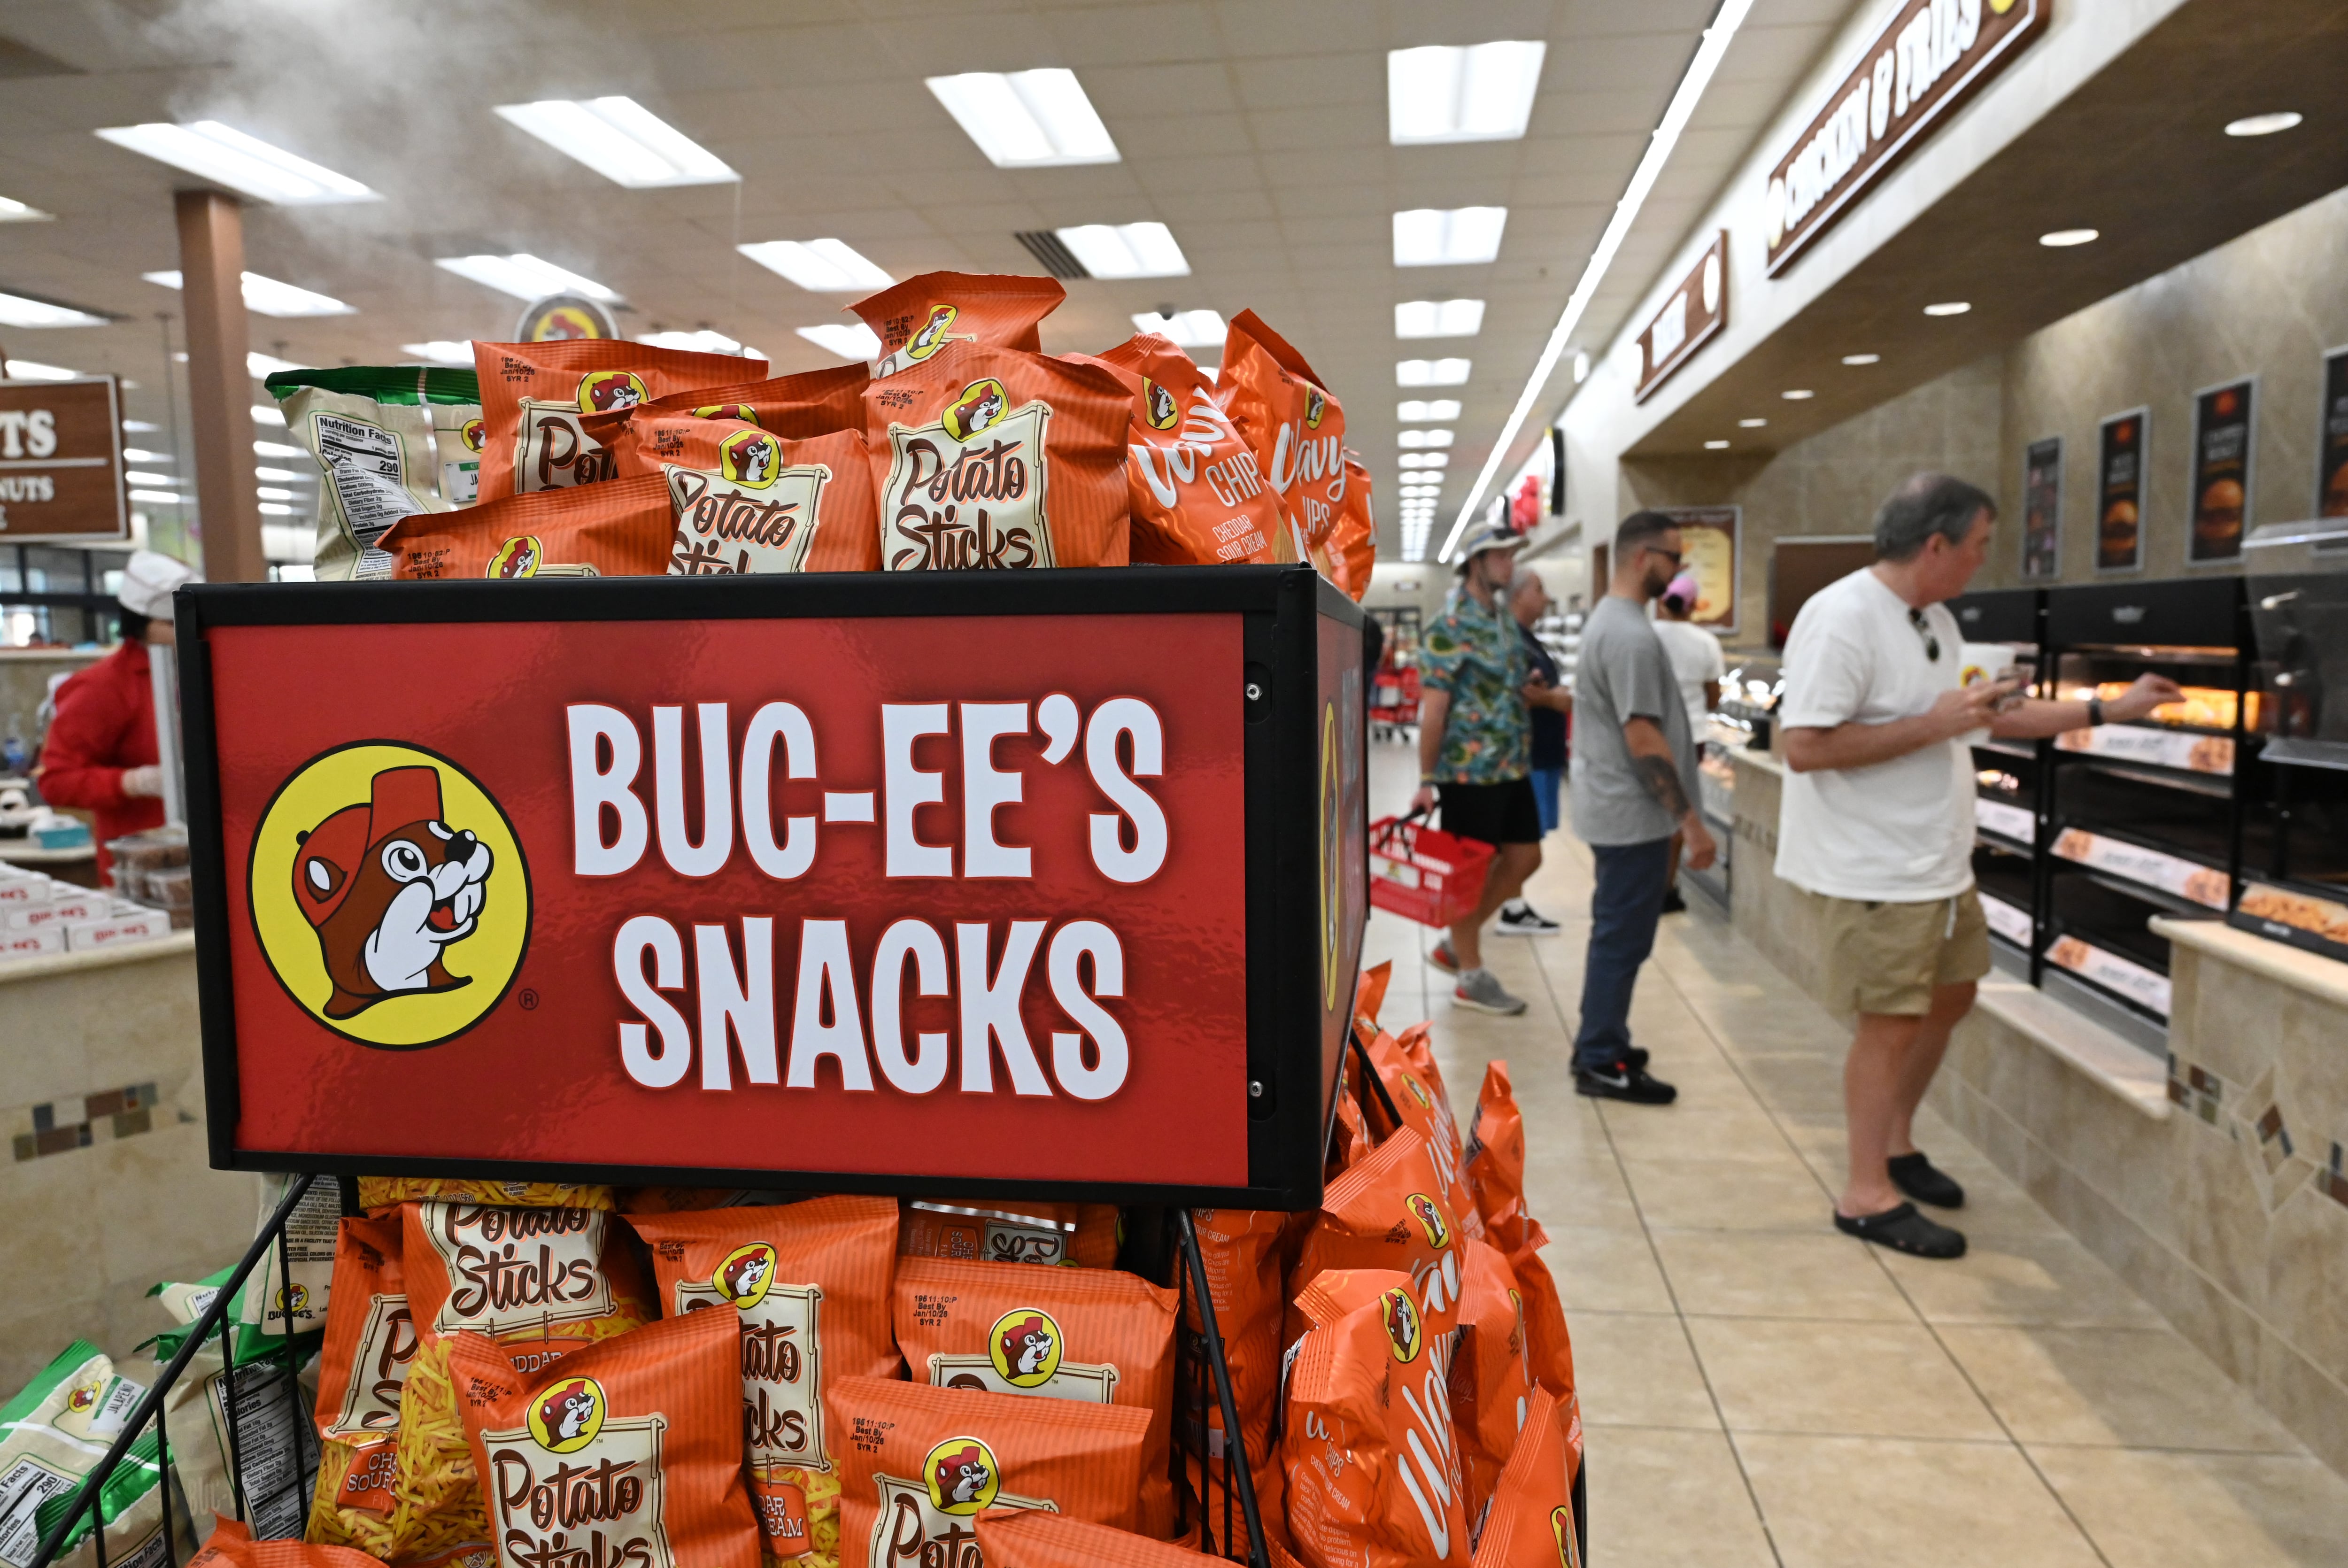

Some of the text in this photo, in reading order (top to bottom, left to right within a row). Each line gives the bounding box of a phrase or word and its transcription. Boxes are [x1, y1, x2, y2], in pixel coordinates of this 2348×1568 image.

[320, 417, 392, 444] Nutrition Facts
[379, 461, 398, 473] 290
[900, 438, 1027, 506] Potato
[673, 470, 801, 549] Potato
[892, 503, 1034, 570] Sticks
[1212, 514, 1254, 543] CHEDDAR
[1241, 530, 1267, 555] CREAM
[566, 691, 1169, 885] BUC-EE'S
[611, 914, 1131, 1102] SNACKS
[1208, 1231, 1229, 1243] CREAM
[451, 1244, 595, 1315] Sticks
[856, 1426, 883, 1437] Best By
[857, 1443, 871, 1452] SYR
[1325, 1442, 1344, 1477] CHIPS
[0, 1466, 29, 1488] Facts
[37, 1476, 58, 1494] 290
[491, 1449, 643, 1530] Potato
[1332, 1487, 1350, 1511] CREAM
[1324, 1545, 1348, 1557] delicious
[1327, 1535, 1352, 1547] problem.
